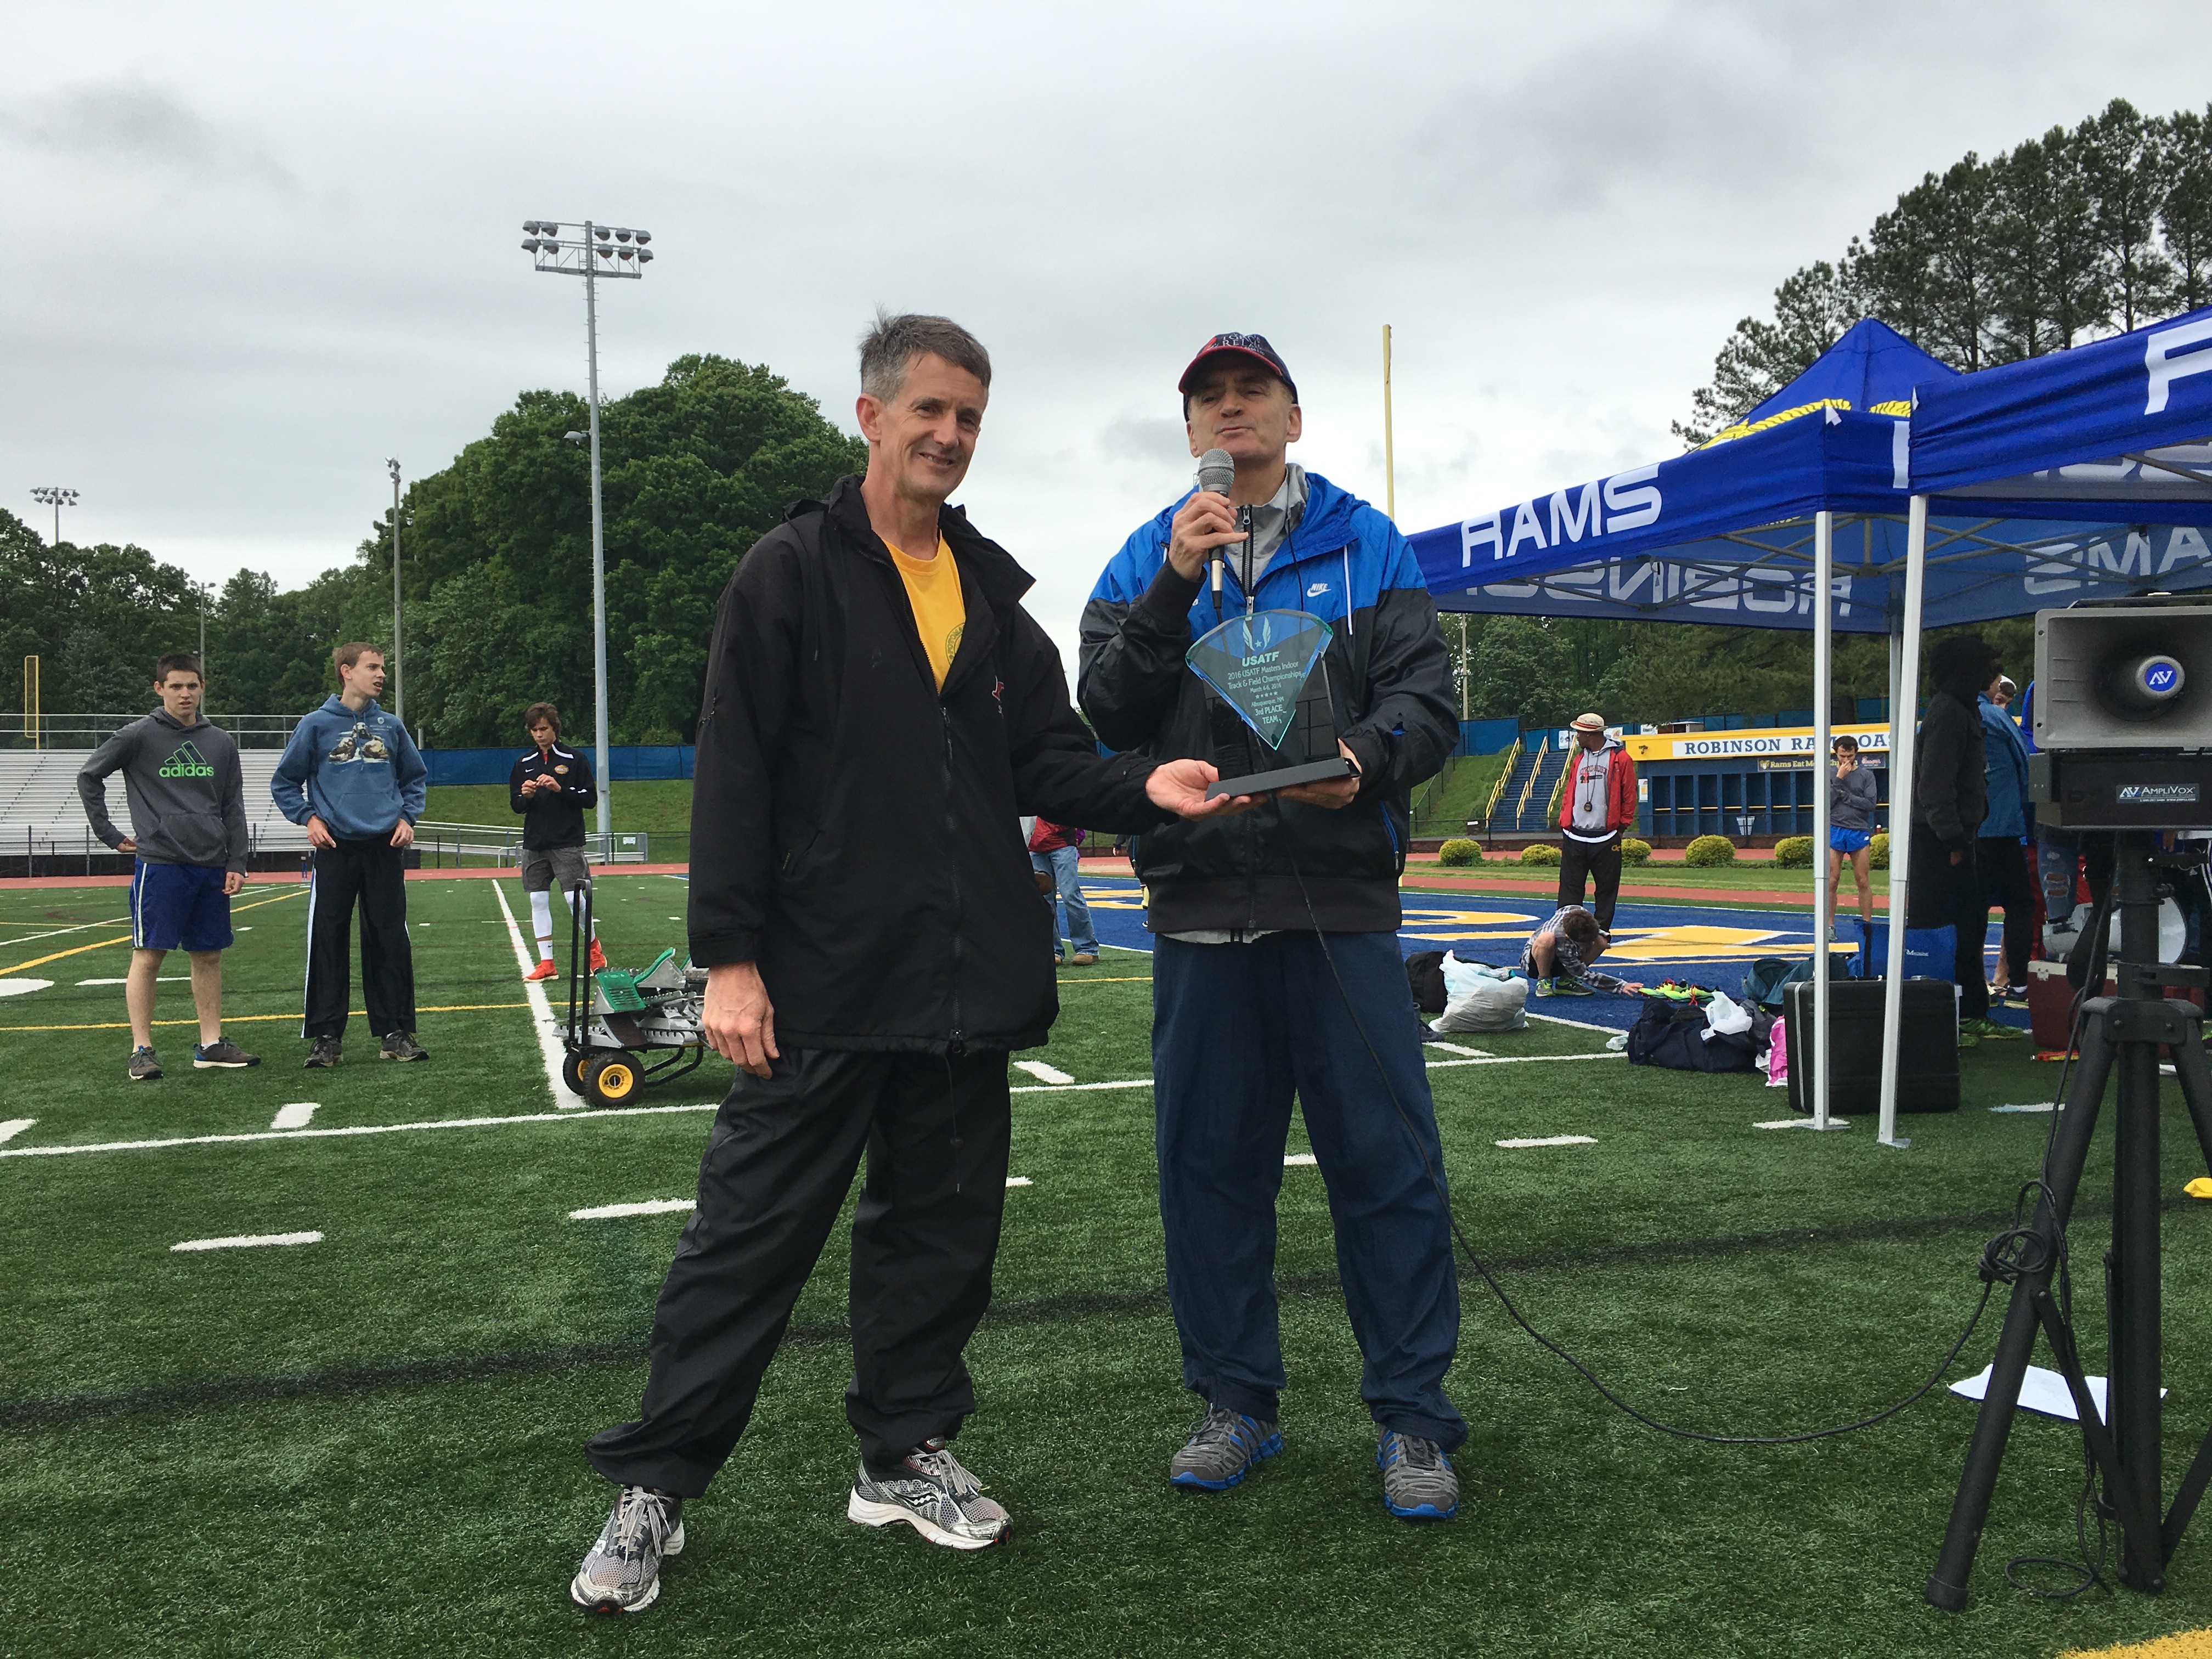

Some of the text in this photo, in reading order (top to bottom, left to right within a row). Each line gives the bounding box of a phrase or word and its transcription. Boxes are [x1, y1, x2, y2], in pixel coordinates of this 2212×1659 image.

[1462, 463, 1662, 567] RAMS
[1311, 583, 1328, 591] NIKE
[1242, 651, 1279, 667] USATF
[1228, 661, 1299, 680] 2016 USATF Masters Indoor
[2149, 670, 2172, 685] AV
[1228, 670, 1301, 690] Track & Field Championships
[1255, 704, 1283, 716] 3rd PLACE
[1262, 715, 1278, 724] TEAM
[1685, 738, 1780, 754] ROBINSON
[159, 763, 214, 777] adidas
